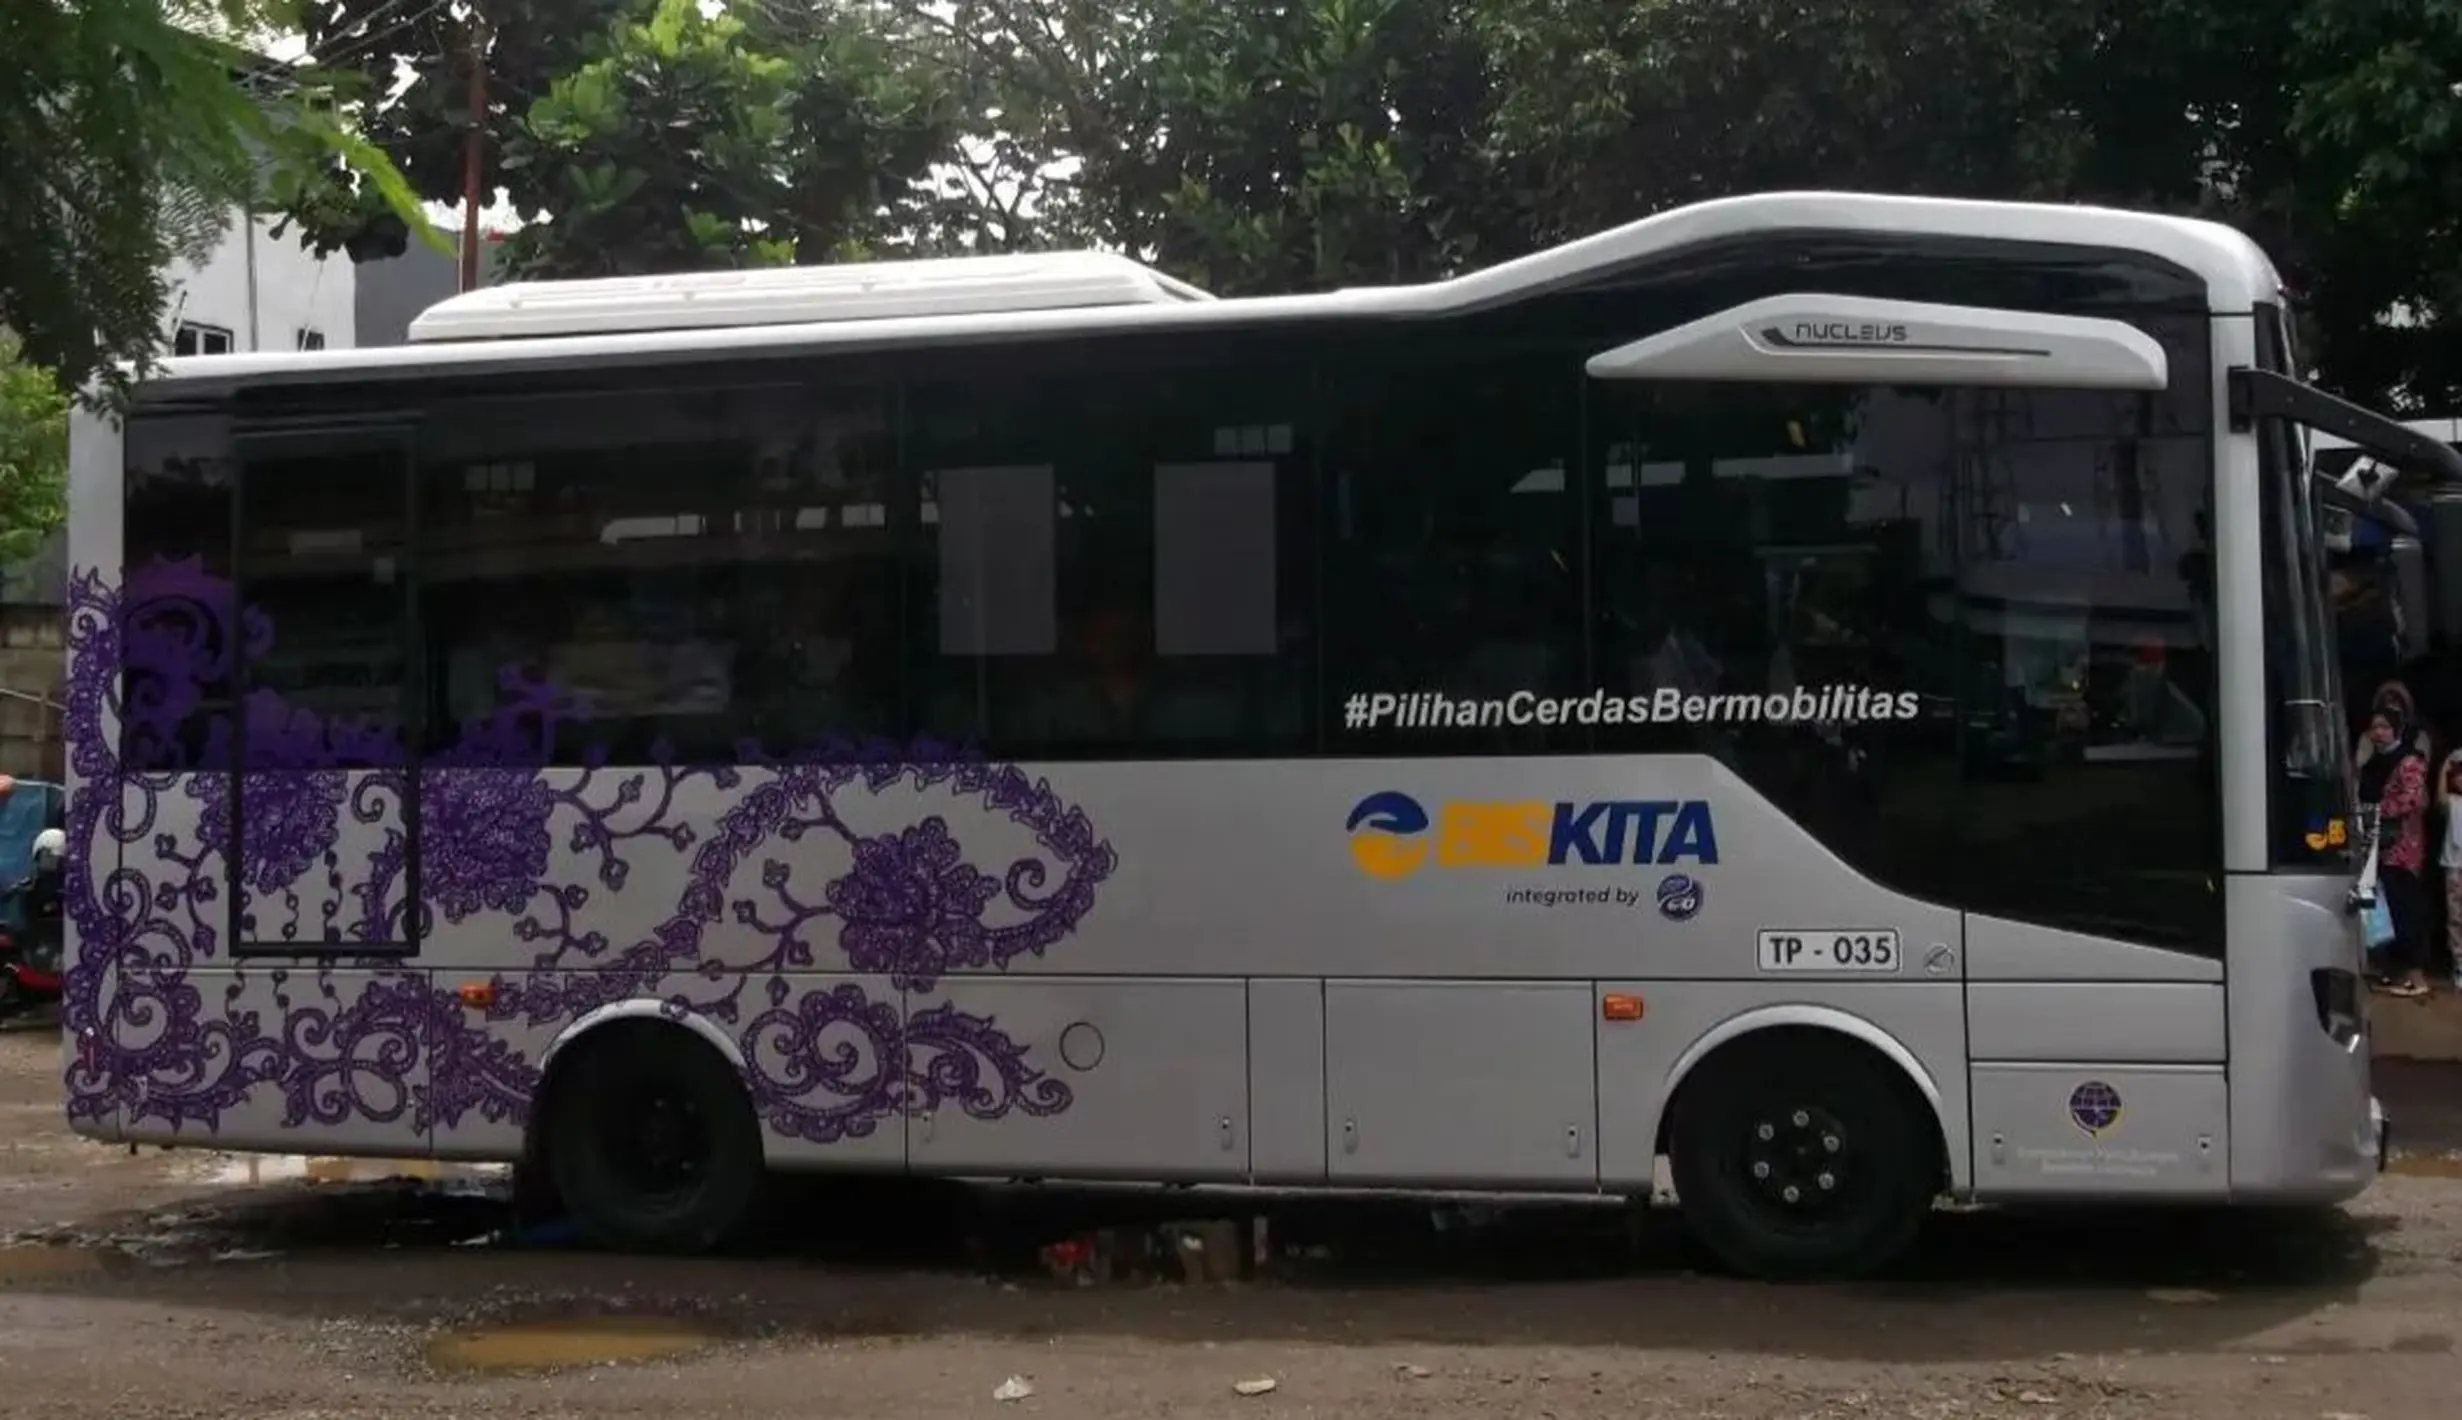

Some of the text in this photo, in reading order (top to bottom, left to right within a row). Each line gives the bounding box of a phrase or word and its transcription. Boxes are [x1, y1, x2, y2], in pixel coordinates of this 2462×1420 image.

[1796, 323, 1907, 341] NUCLEUS
[1344, 685, 1920, 728] #PilihanCerdasBermobilitas
[1506, 886, 1640, 907] integrated by
[1769, 937, 1802, 964] TP
[1833, 936, 1890, 964] 035
